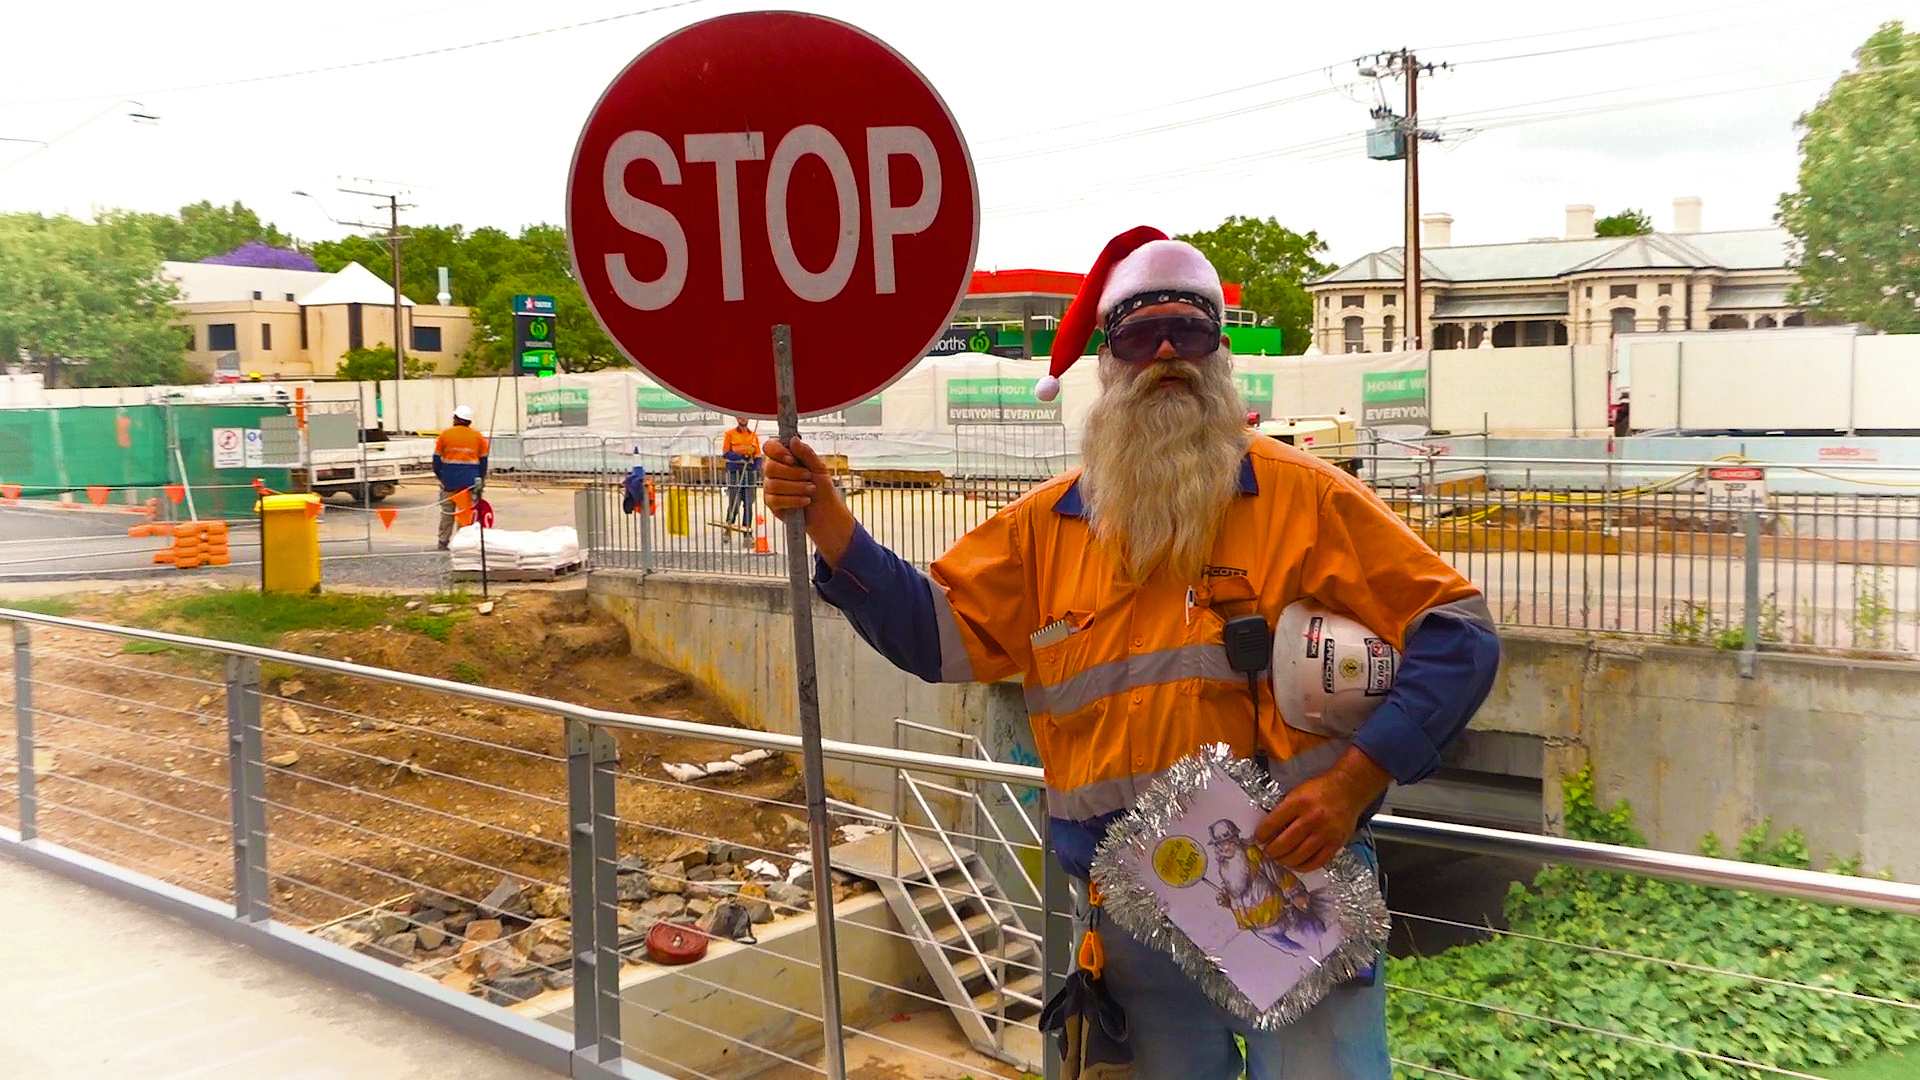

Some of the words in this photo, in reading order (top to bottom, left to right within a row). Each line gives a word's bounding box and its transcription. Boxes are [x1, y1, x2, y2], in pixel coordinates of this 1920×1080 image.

[602, 123, 943, 311] STOP
[1366, 379, 1408, 393] HOME
[950, 408, 1001, 419] EVERYONE
[1003, 408, 1057, 420] EVERYDAY
